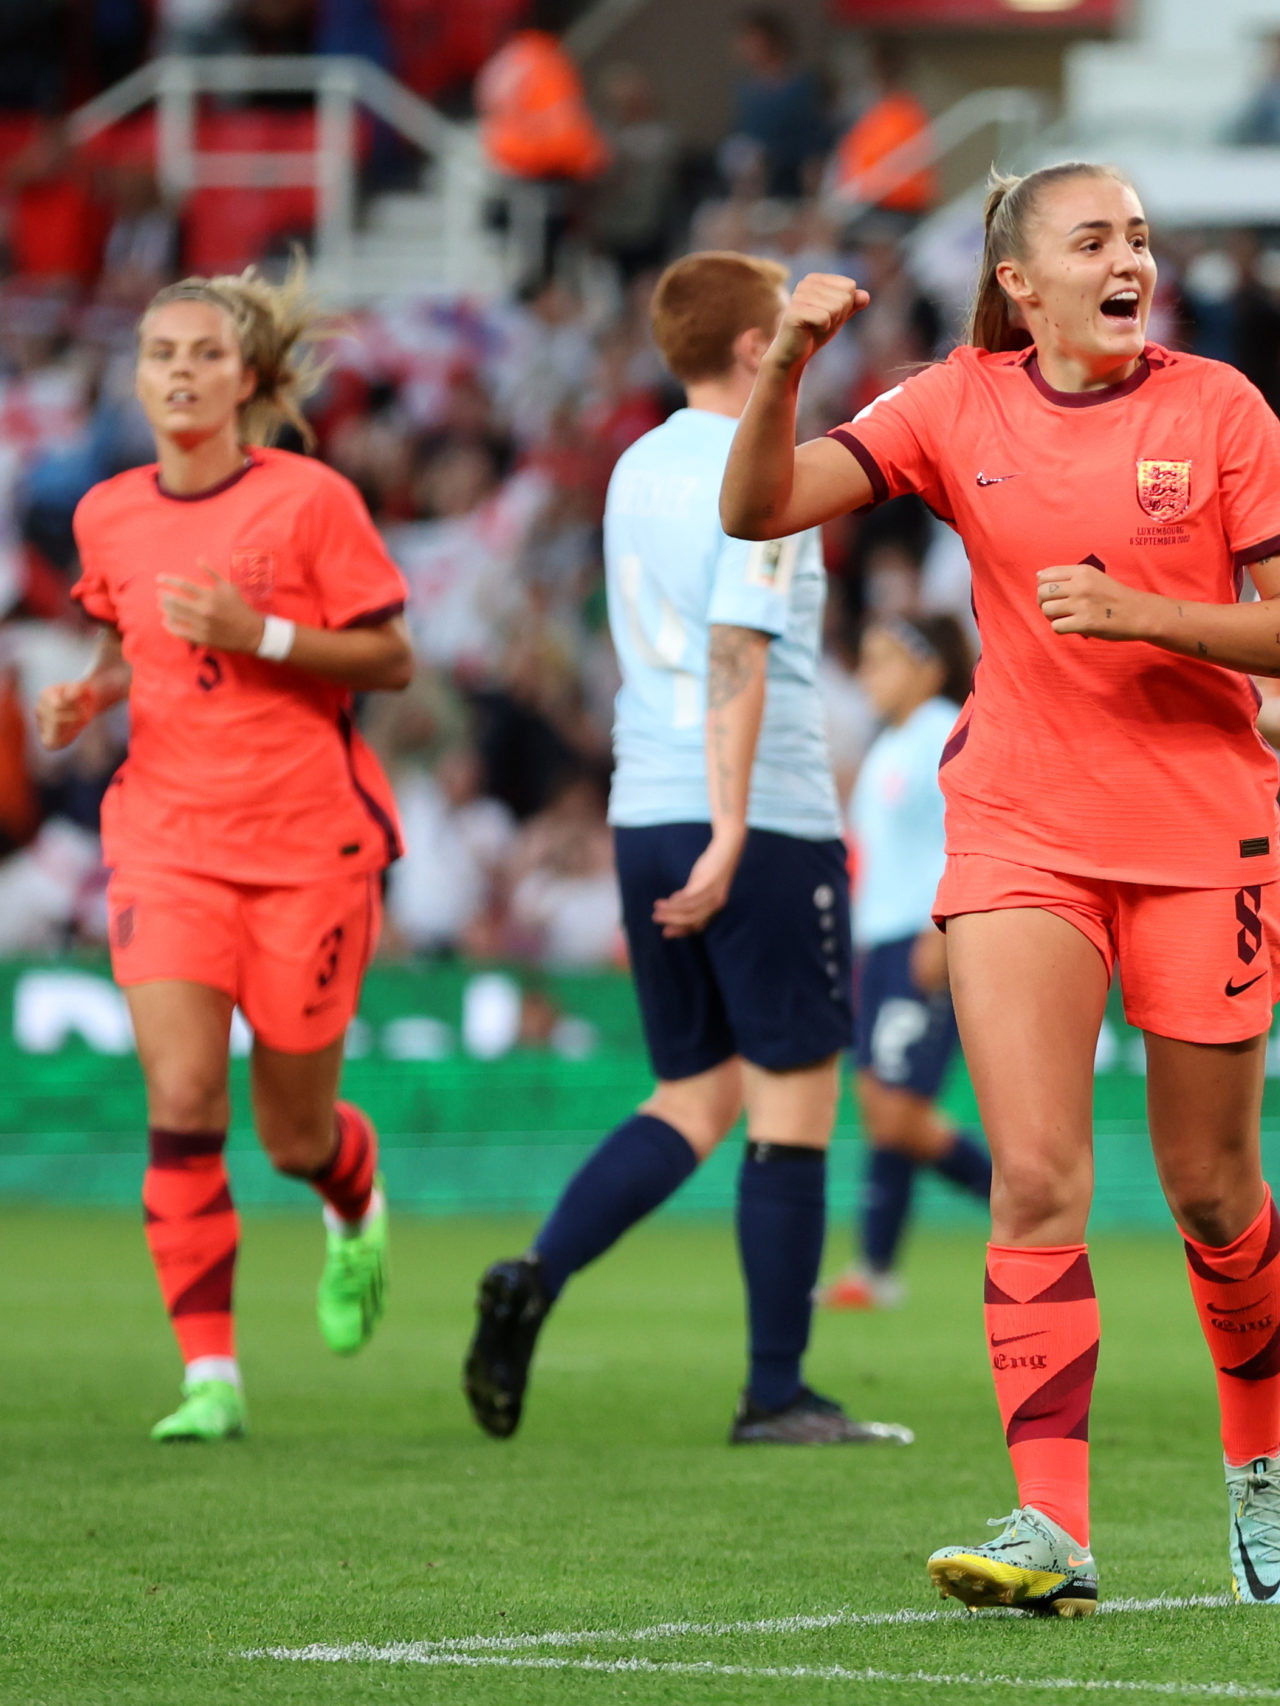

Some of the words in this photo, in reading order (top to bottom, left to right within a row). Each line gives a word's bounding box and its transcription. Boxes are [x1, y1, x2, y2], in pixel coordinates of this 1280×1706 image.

[1136, 526, 1184, 535] LUXEMBOURG
[1135, 536, 1176, 545] SEPTEMBER
[1234, 884, 1262, 966] 8
[317, 925, 344, 989] 3
[993, 1353, 1048, 1370] Eng
